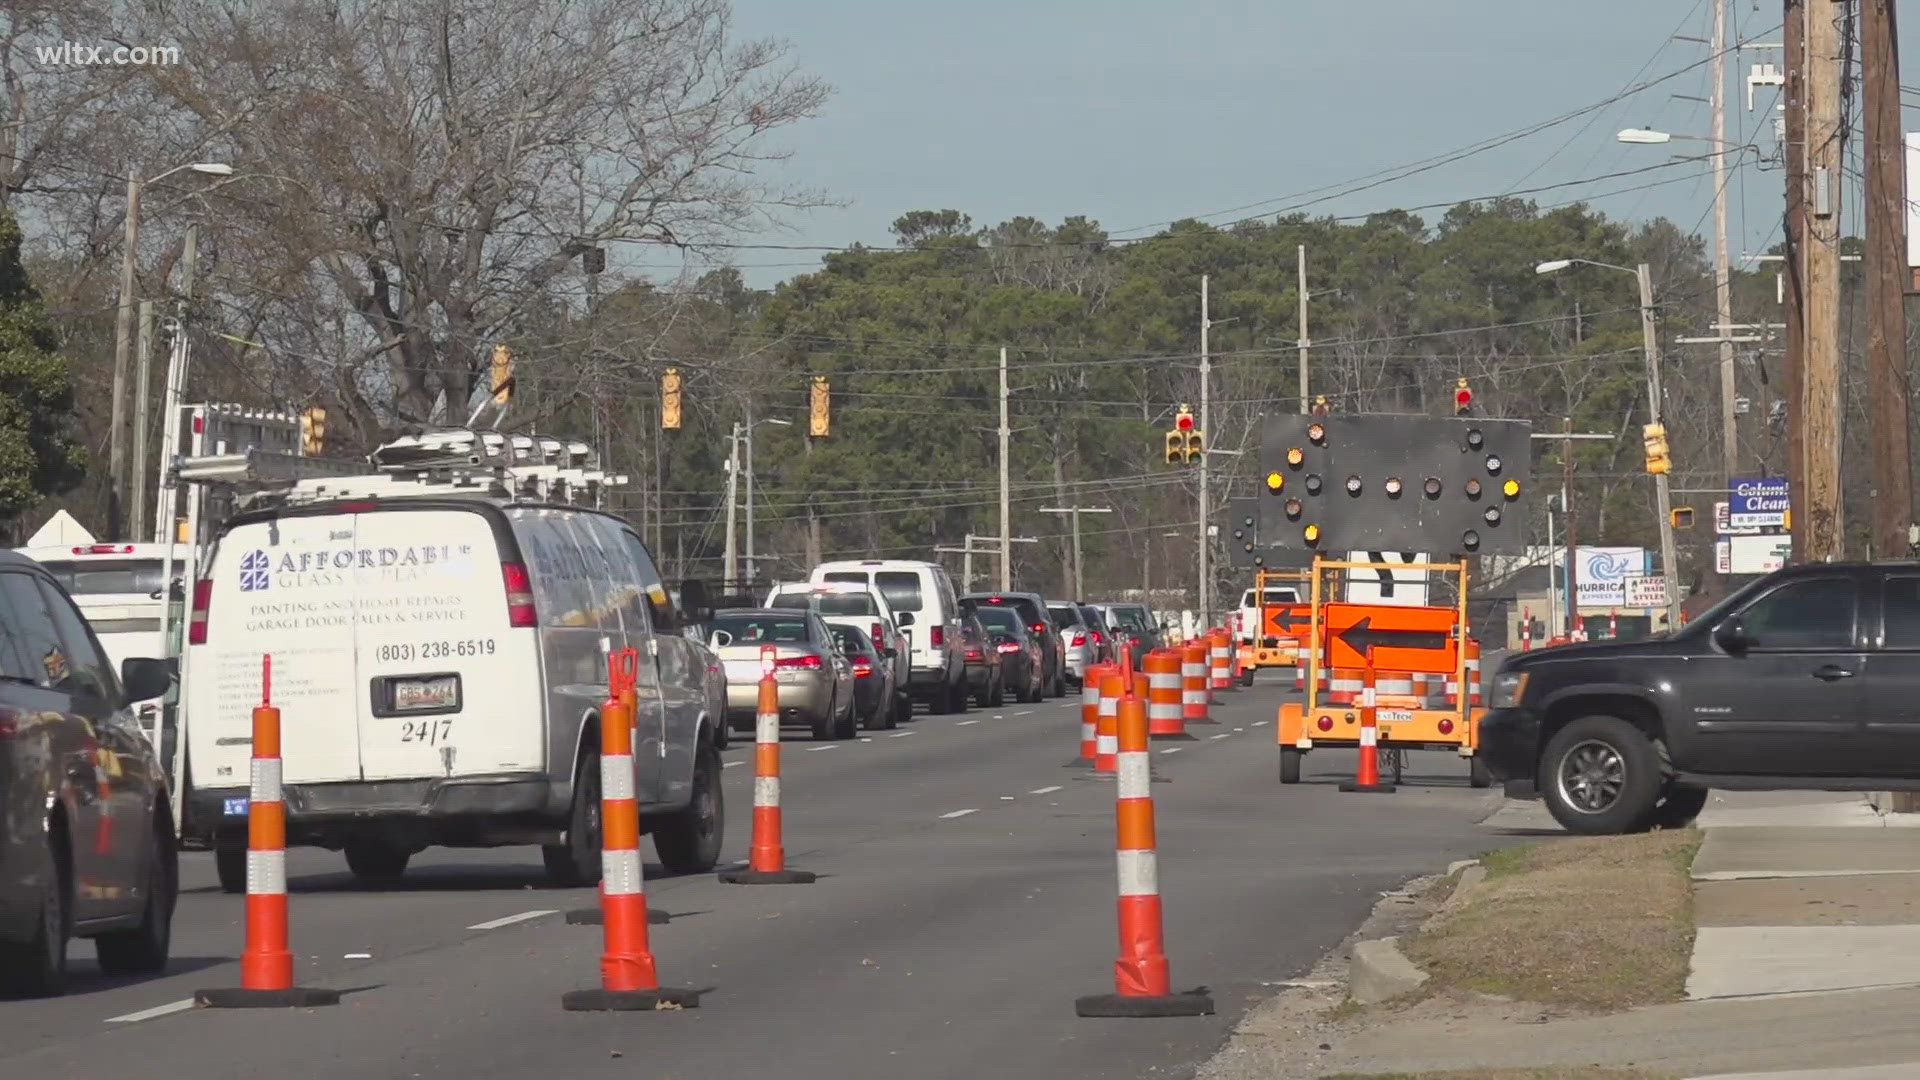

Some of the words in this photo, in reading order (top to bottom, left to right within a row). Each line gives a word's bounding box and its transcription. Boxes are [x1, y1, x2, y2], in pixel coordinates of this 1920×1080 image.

[246, 617, 299, 632] GARAGE
[305, 615, 348, 628] DOOR
[395, 610, 406, 623] &
[410, 609, 467, 622] SERVICE
[250, 602, 317, 616] PAINTING
[376, 643, 416, 663] (803)
[422, 638, 495, 658] 238-6519
[401, 720, 453, 747] 24/7
